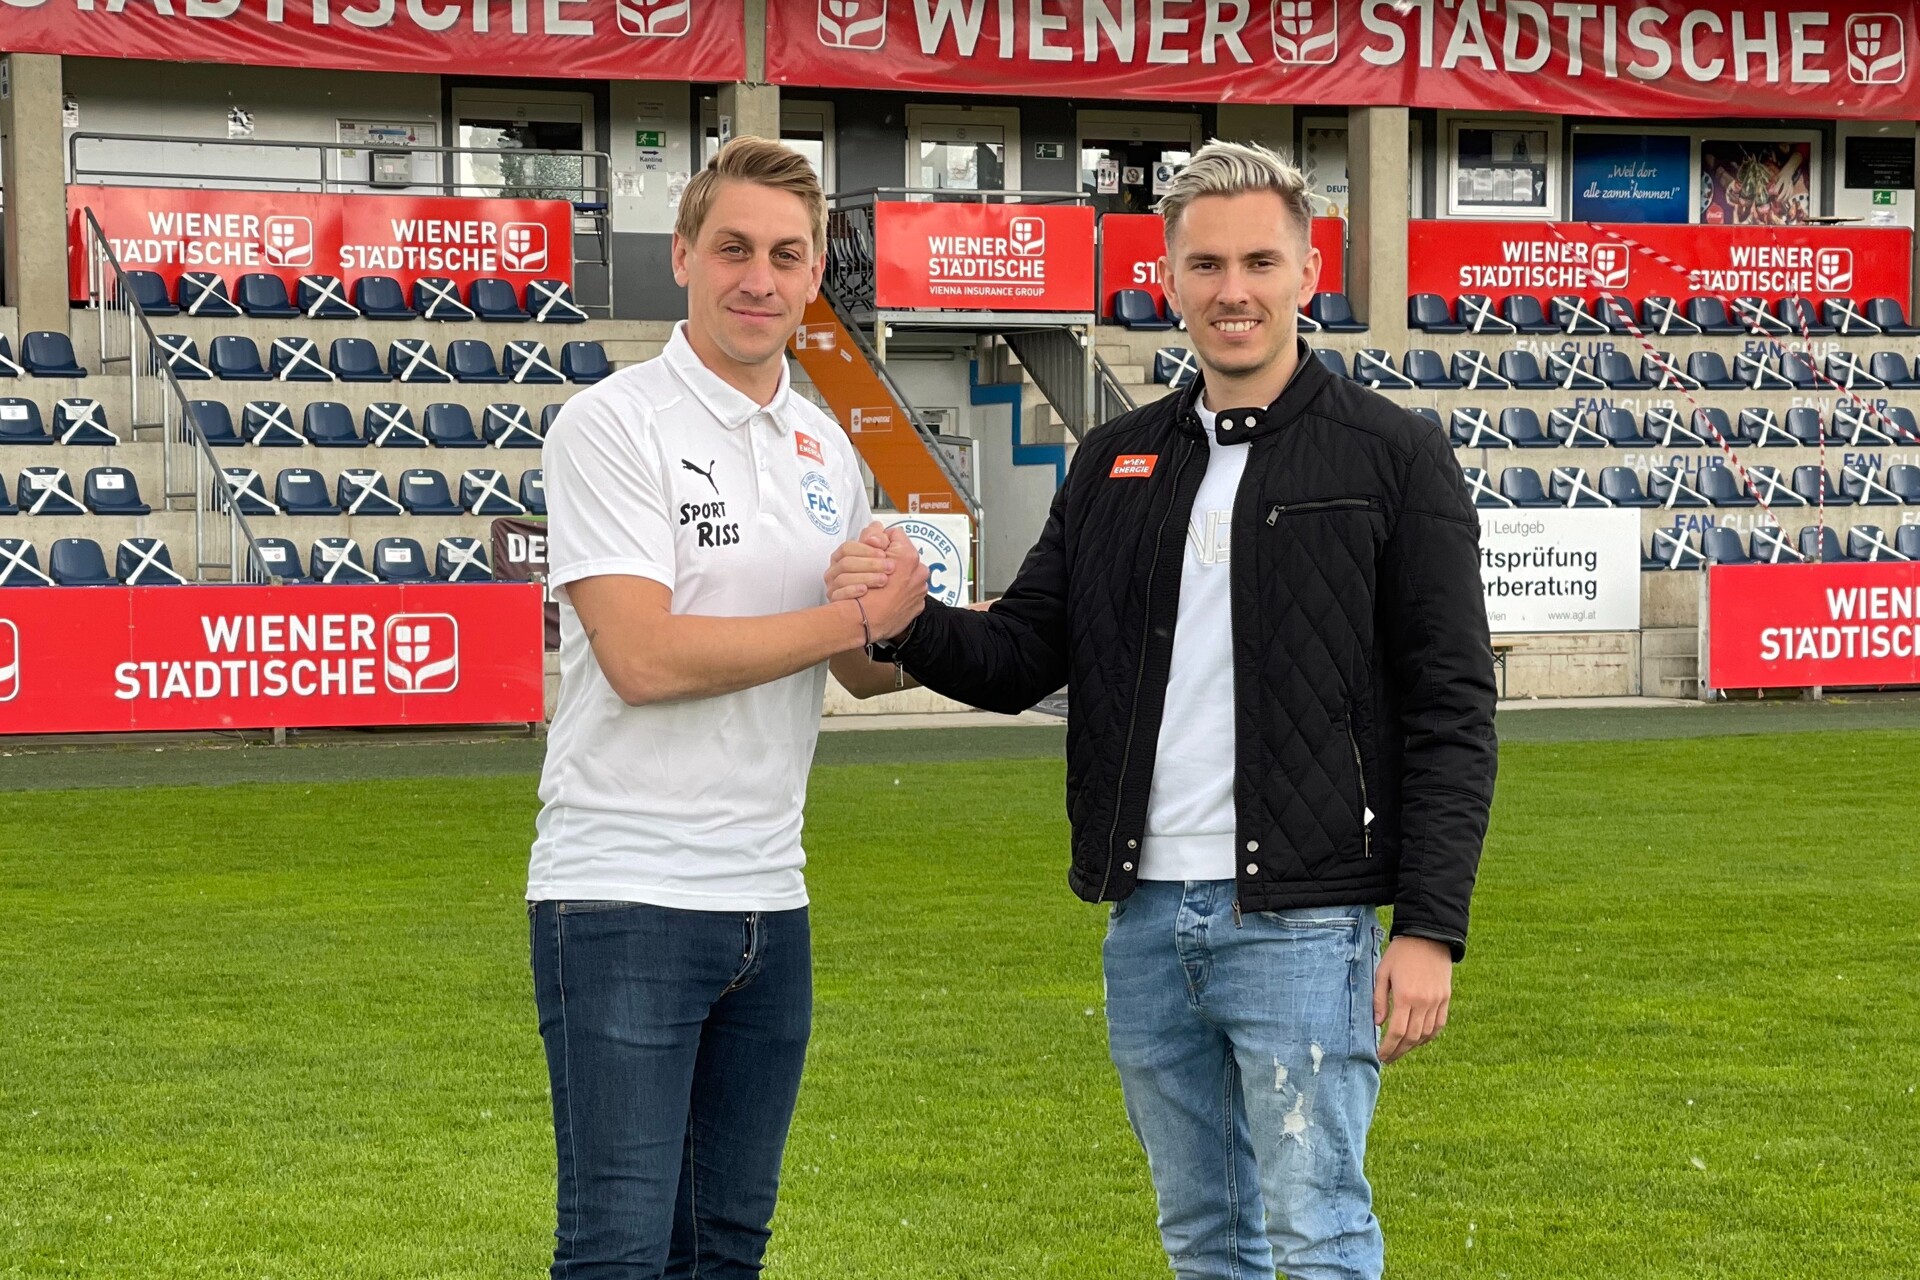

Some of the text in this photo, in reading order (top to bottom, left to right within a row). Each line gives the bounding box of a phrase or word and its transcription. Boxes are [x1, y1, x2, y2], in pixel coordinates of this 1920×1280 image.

[914, 0, 1830, 83] WIENER STÄDTISCHE
[1637, 162, 1658, 178] dort
[1583, 181, 1600, 198] alle
[148, 211, 260, 238] WIENER
[391, 219, 497, 244] WIENER
[928, 236, 1008, 256] WIENER
[1502, 241, 1589, 263] WIENER
[1730, 246, 1813, 268] WIENER
[339, 245, 498, 271] STÄDTISCHE
[929, 258, 1045, 278] STÄDTISCHE
[1133, 261, 1162, 284] ST
[1460, 266, 1588, 288] STÄDTISCHE
[1689, 269, 1813, 292] STÄDTISCHE
[929, 286, 1045, 297] VIENNA INSURANCE GROUP
[1516, 340, 1556, 358] FAN
[1745, 341, 1781, 358] FAN
[1575, 398, 1614, 415] FAN
[1791, 397, 1829, 415] FAN
[1114, 466, 1149, 474] ENERGIE
[1123, 458, 1146, 466] WIEN
[1623, 454, 1664, 472] FAN
[1843, 453, 1882, 470] FAN
[680, 502, 726, 525] SPORT
[807, 493, 836, 514] FAC
[697, 521, 740, 548] RISS
[1494, 520, 1545, 536] Leutgeb
[1675, 514, 1715, 533] FAN
[507, 533, 549, 563] DE
[905, 525, 952, 555] SDORFER
[1483, 576, 1598, 601] rberatung
[1826, 587, 1920, 620] WIEN
[1548, 609, 1597, 622] www.agl.at
[201, 614, 377, 653] WIENER
[1761, 624, 1920, 660] STÄDTISC
[114, 658, 377, 700] STÄDTISCHE
